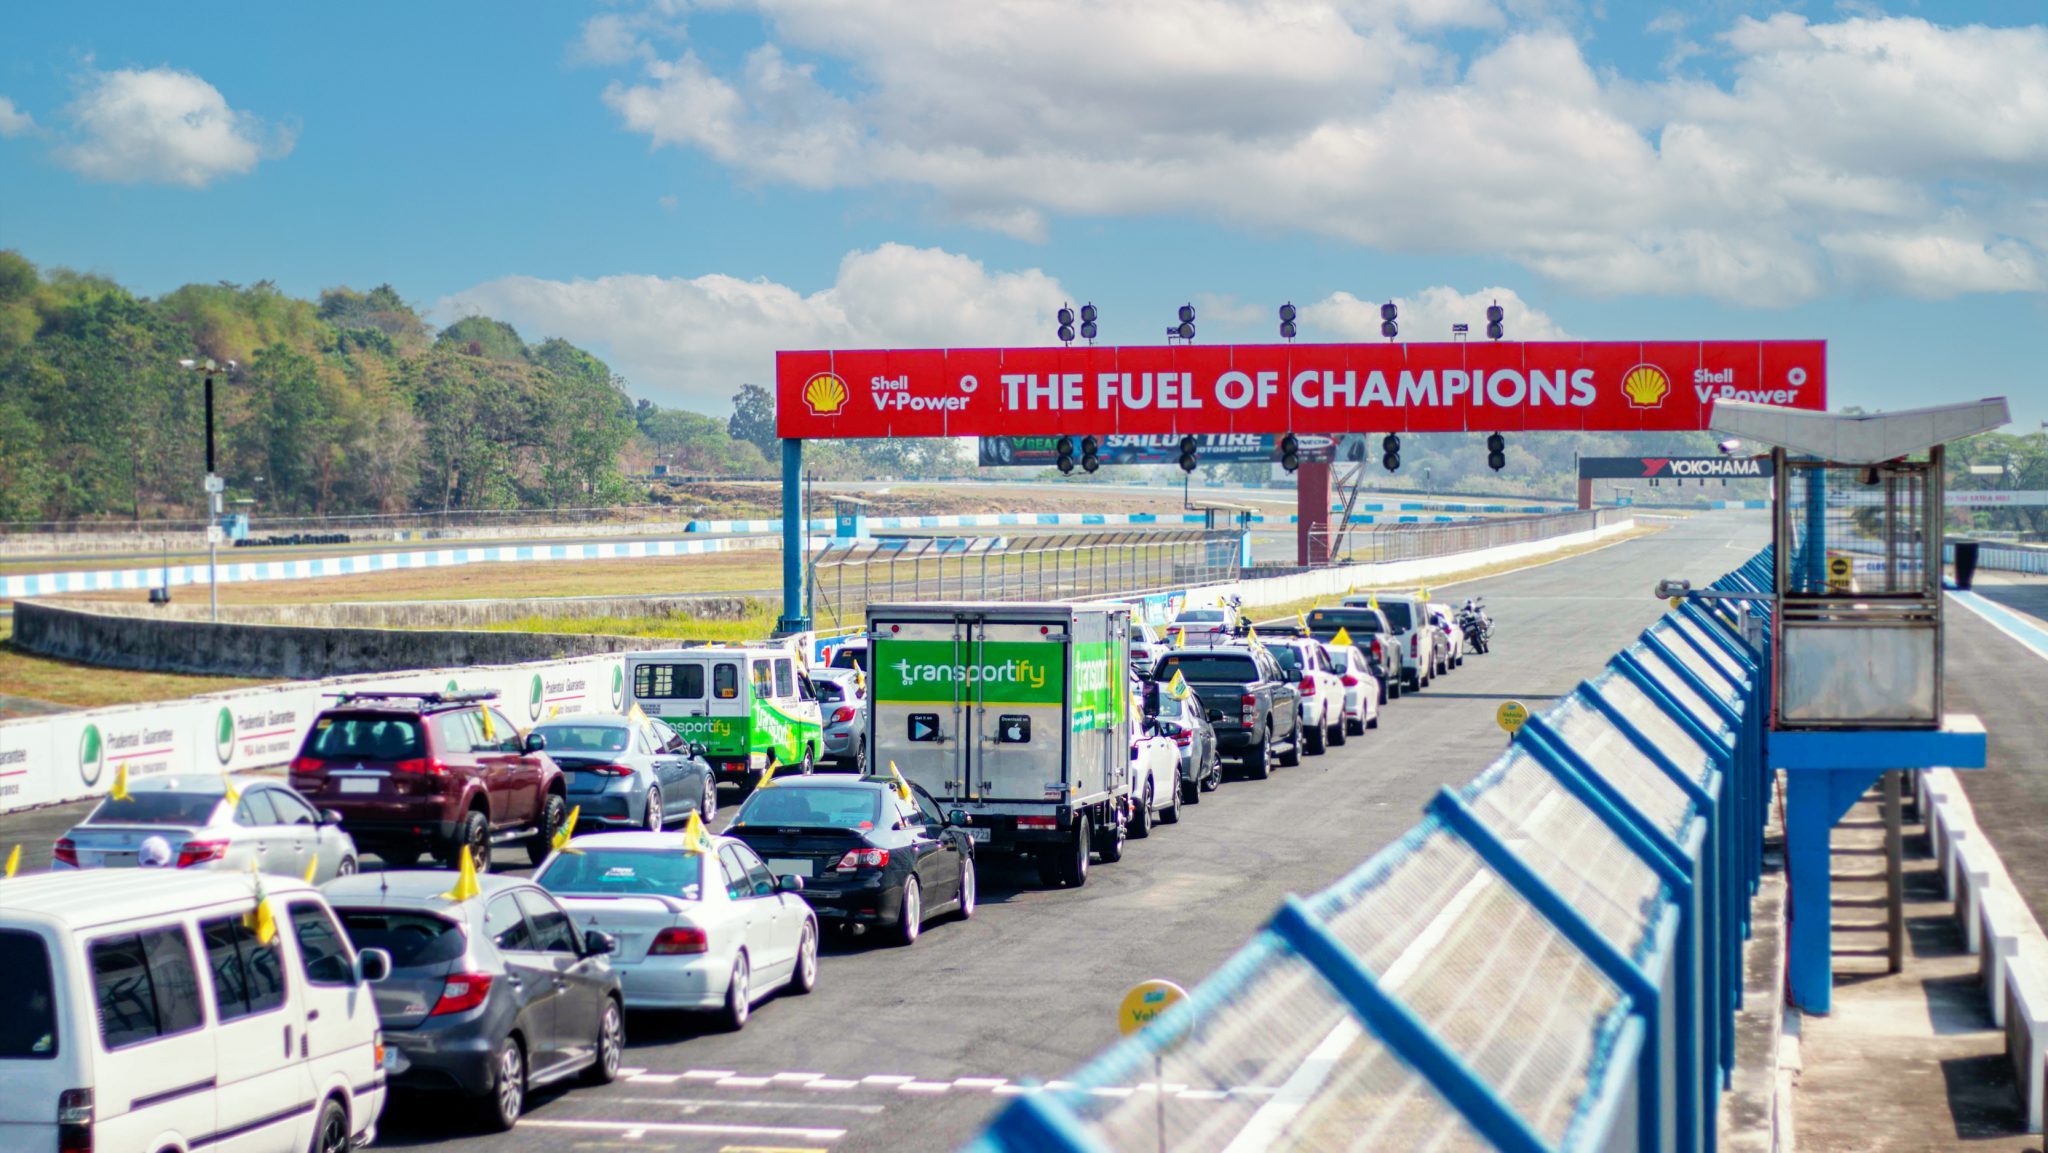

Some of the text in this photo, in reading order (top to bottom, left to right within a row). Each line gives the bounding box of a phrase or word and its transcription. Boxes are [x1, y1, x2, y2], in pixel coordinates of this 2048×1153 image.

[870, 375, 909, 391] Shell
[1693, 368, 1733, 383] Shell
[1000, 368, 1597, 410] THE FUEL OF CHAMPIONS
[1694, 385, 1799, 404] V-Power
[871, 392, 970, 411] V-Power
[1106, 433, 1262, 447] SAILU TIRE
[1196, 445, 1261, 454] OTORSPORT
[1669, 460, 1761, 475] YOKOHAMA
[898, 658, 1045, 688] transportify
